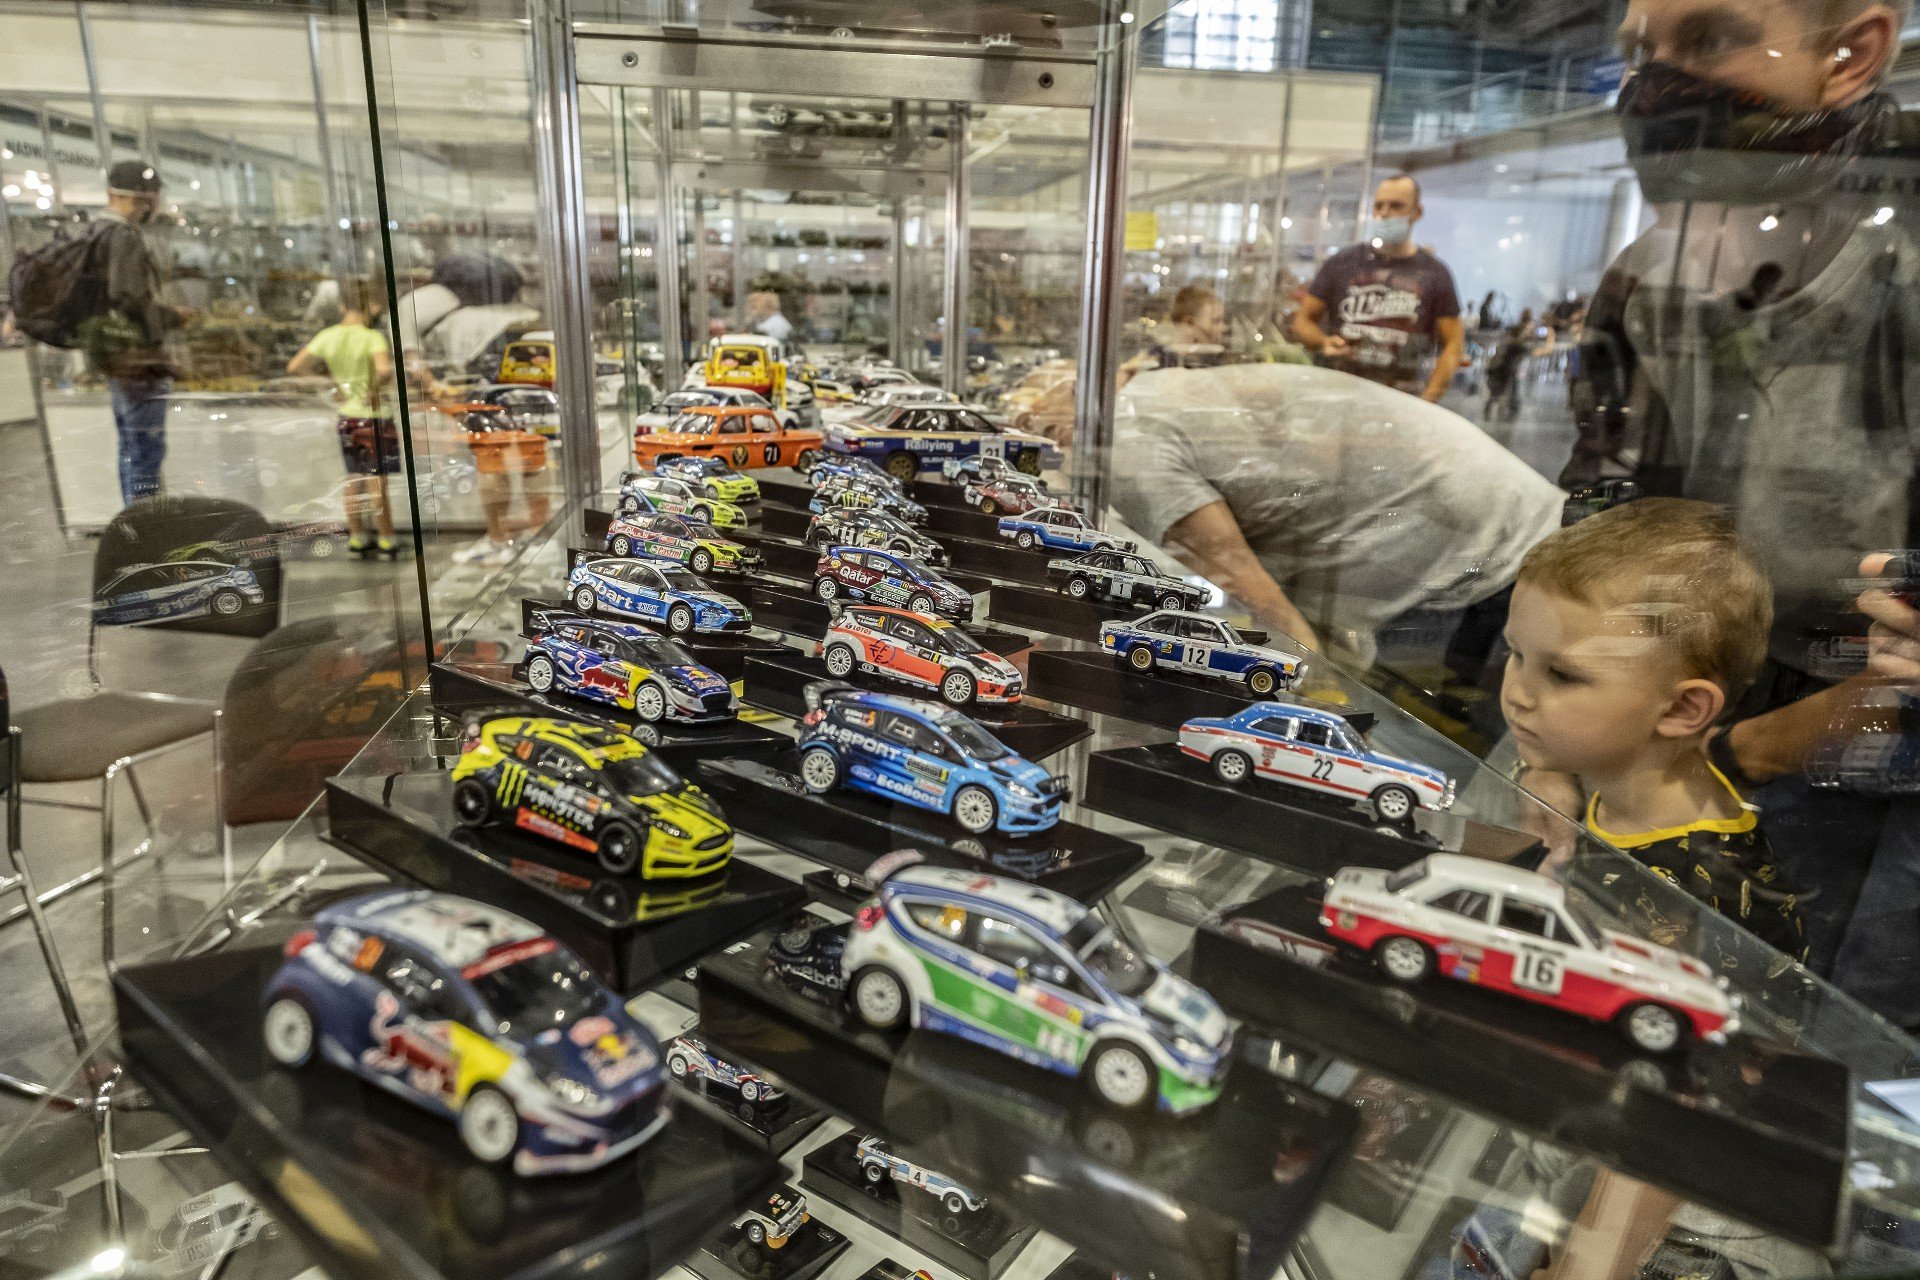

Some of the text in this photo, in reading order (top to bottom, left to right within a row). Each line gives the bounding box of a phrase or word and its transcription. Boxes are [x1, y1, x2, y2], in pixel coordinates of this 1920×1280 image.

[765, 446, 778, 462] 71
[1076, 533, 1081, 543] 5
[658, 546, 682, 559] Castrol
[840, 565, 873, 585] Qatar
[1119, 584, 1124, 595] 1
[870, 594, 903, 608] EcoBoost
[853, 625, 872, 635] LOTOS
[1188, 647, 1206, 665] 12
[1312, 758, 1334, 781] 22
[876, 773, 943, 809] EcoBoost
[523, 783, 595, 831] MONSTER
[1523, 954, 1556, 984] 16
[914, 1172, 921, 1183] 4
